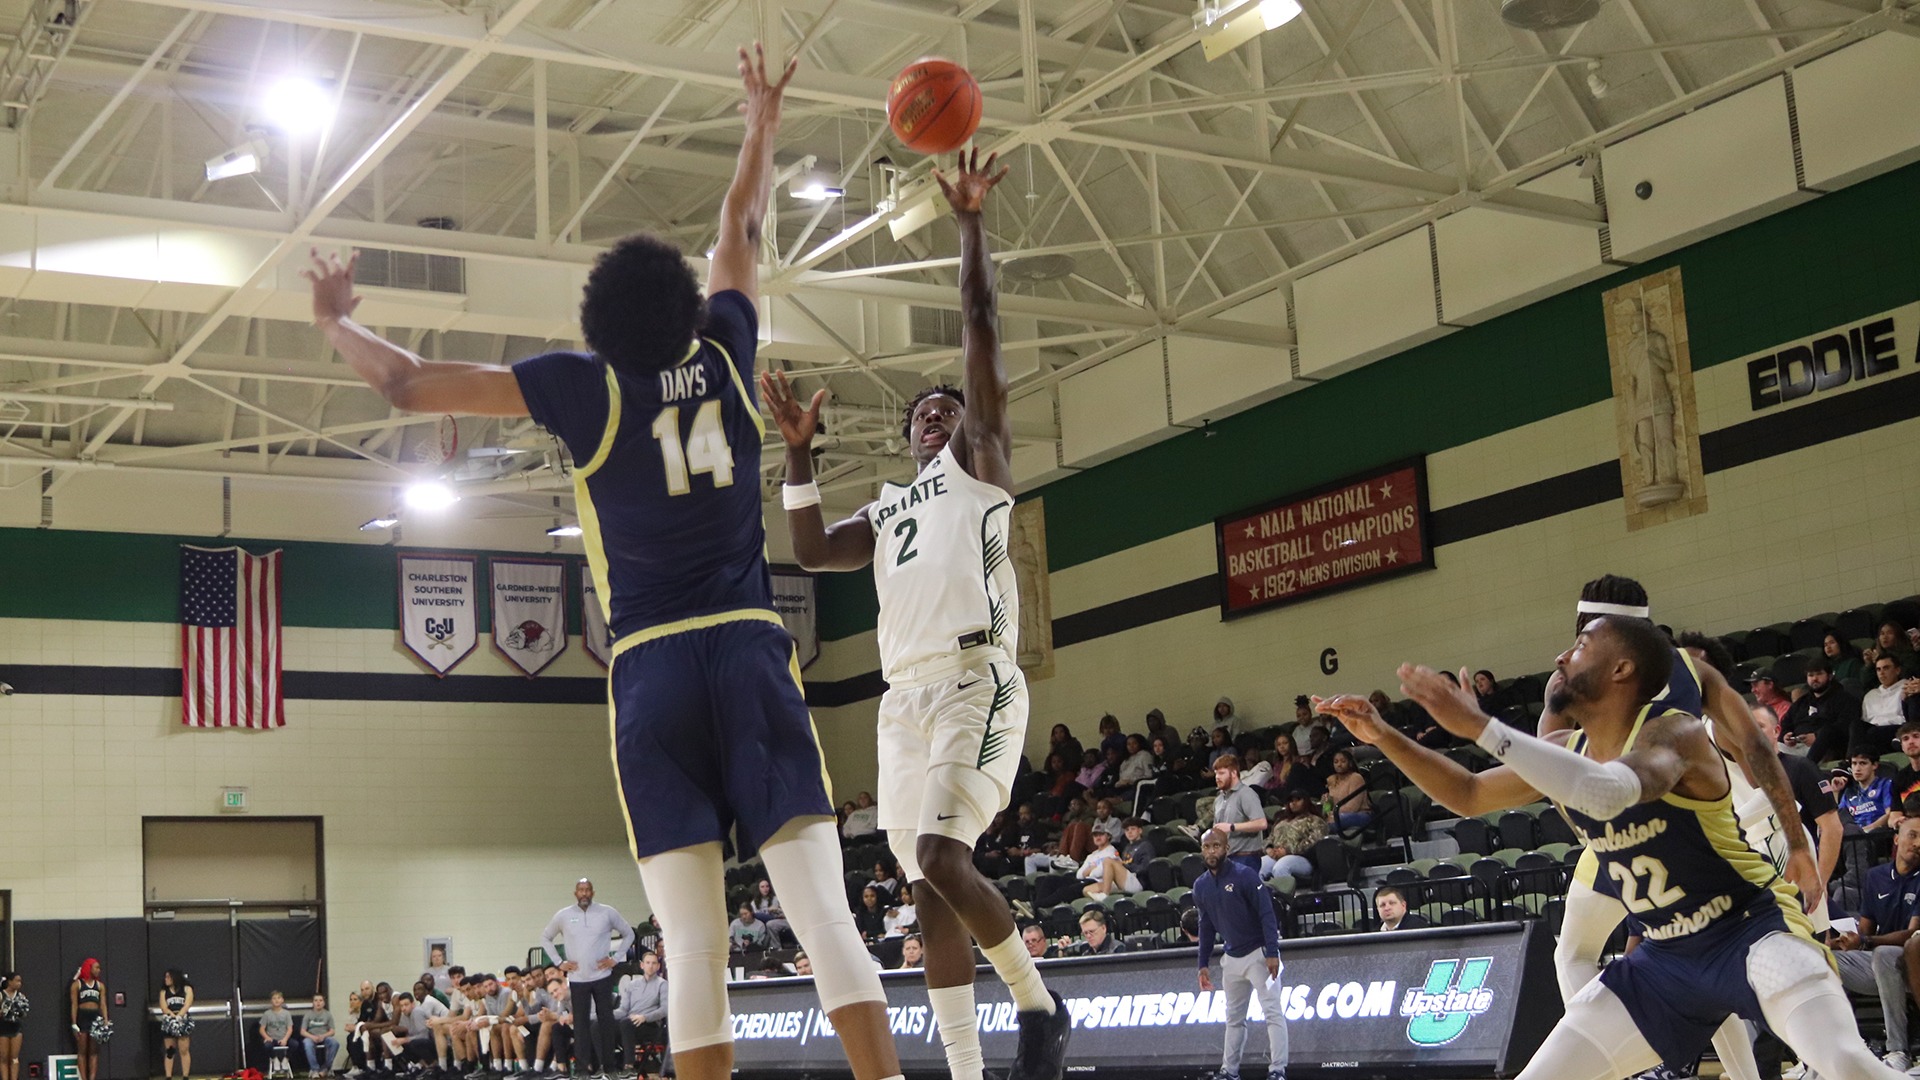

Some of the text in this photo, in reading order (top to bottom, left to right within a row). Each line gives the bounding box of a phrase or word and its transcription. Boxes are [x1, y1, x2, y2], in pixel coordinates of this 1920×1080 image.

[1747, 317, 1899, 411] EDDIE
[660, 364, 707, 402] DAYS
[652, 399, 735, 496] 14
[1260, 484, 1375, 539] NAIA NATIONAL
[894, 517, 918, 567] 2
[1229, 505, 1415, 577] BASKETBALL CHAMPIONS
[408, 573, 467, 582] CHARLESTON
[414, 585, 462, 595] SOUTHERN
[1264, 570, 1296, 598] 1982
[1333, 550, 1381, 579] DIVISION
[412, 597, 465, 607] UNIVERSITY
[505, 595, 552, 604] UNIVERSITY
[773, 594, 805, 603] NTHROP
[776, 606, 808, 614] VERSITY
[425, 618, 454, 640] CSU
[1320, 648, 1338, 675] G
[227, 793, 243, 805] EXIT
[1576, 818, 1667, 852] arleston
[1608, 855, 1686, 913] 22
[1063, 980, 1396, 1029] PSTATESPARAS.COM
[1402, 989, 1493, 1014] Upstate
[887, 1005, 927, 1035] TATS
[976, 1002, 1019, 1032] TURE
